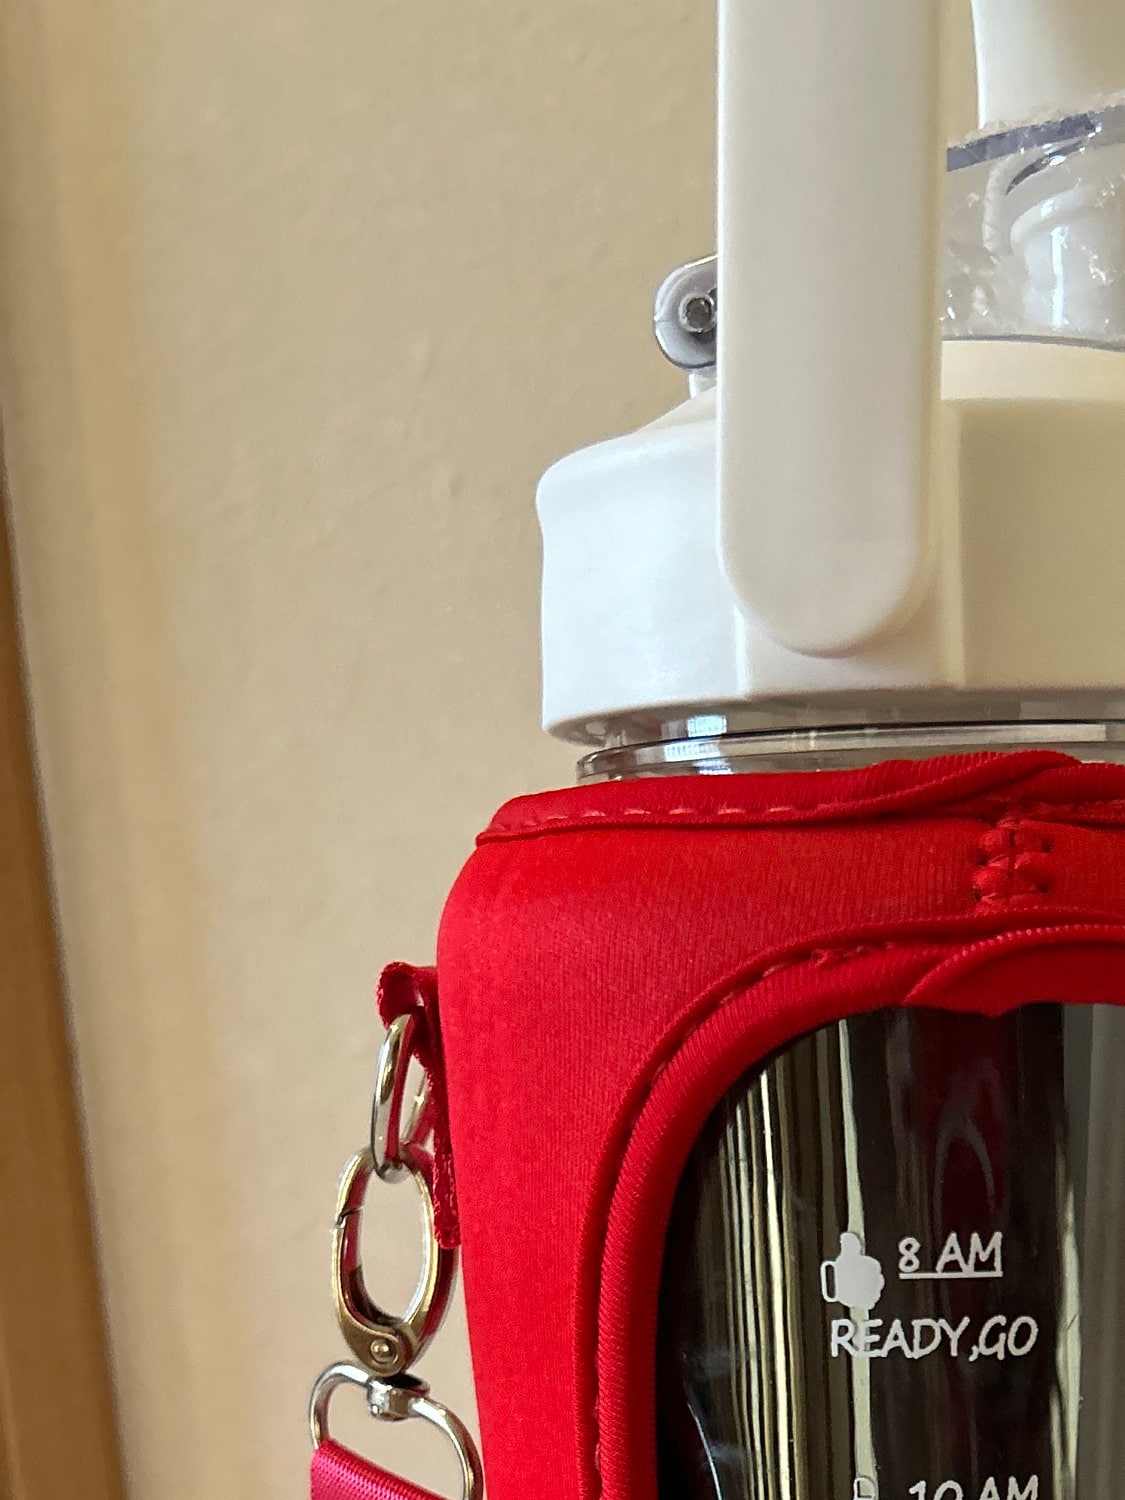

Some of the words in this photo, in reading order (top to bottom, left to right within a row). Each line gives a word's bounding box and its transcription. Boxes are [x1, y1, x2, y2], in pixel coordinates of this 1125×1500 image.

[898, 1236, 920, 1273] 8
[936, 1231, 1003, 1274] AM
[831, 1315, 1038, 1361] READY,GO
